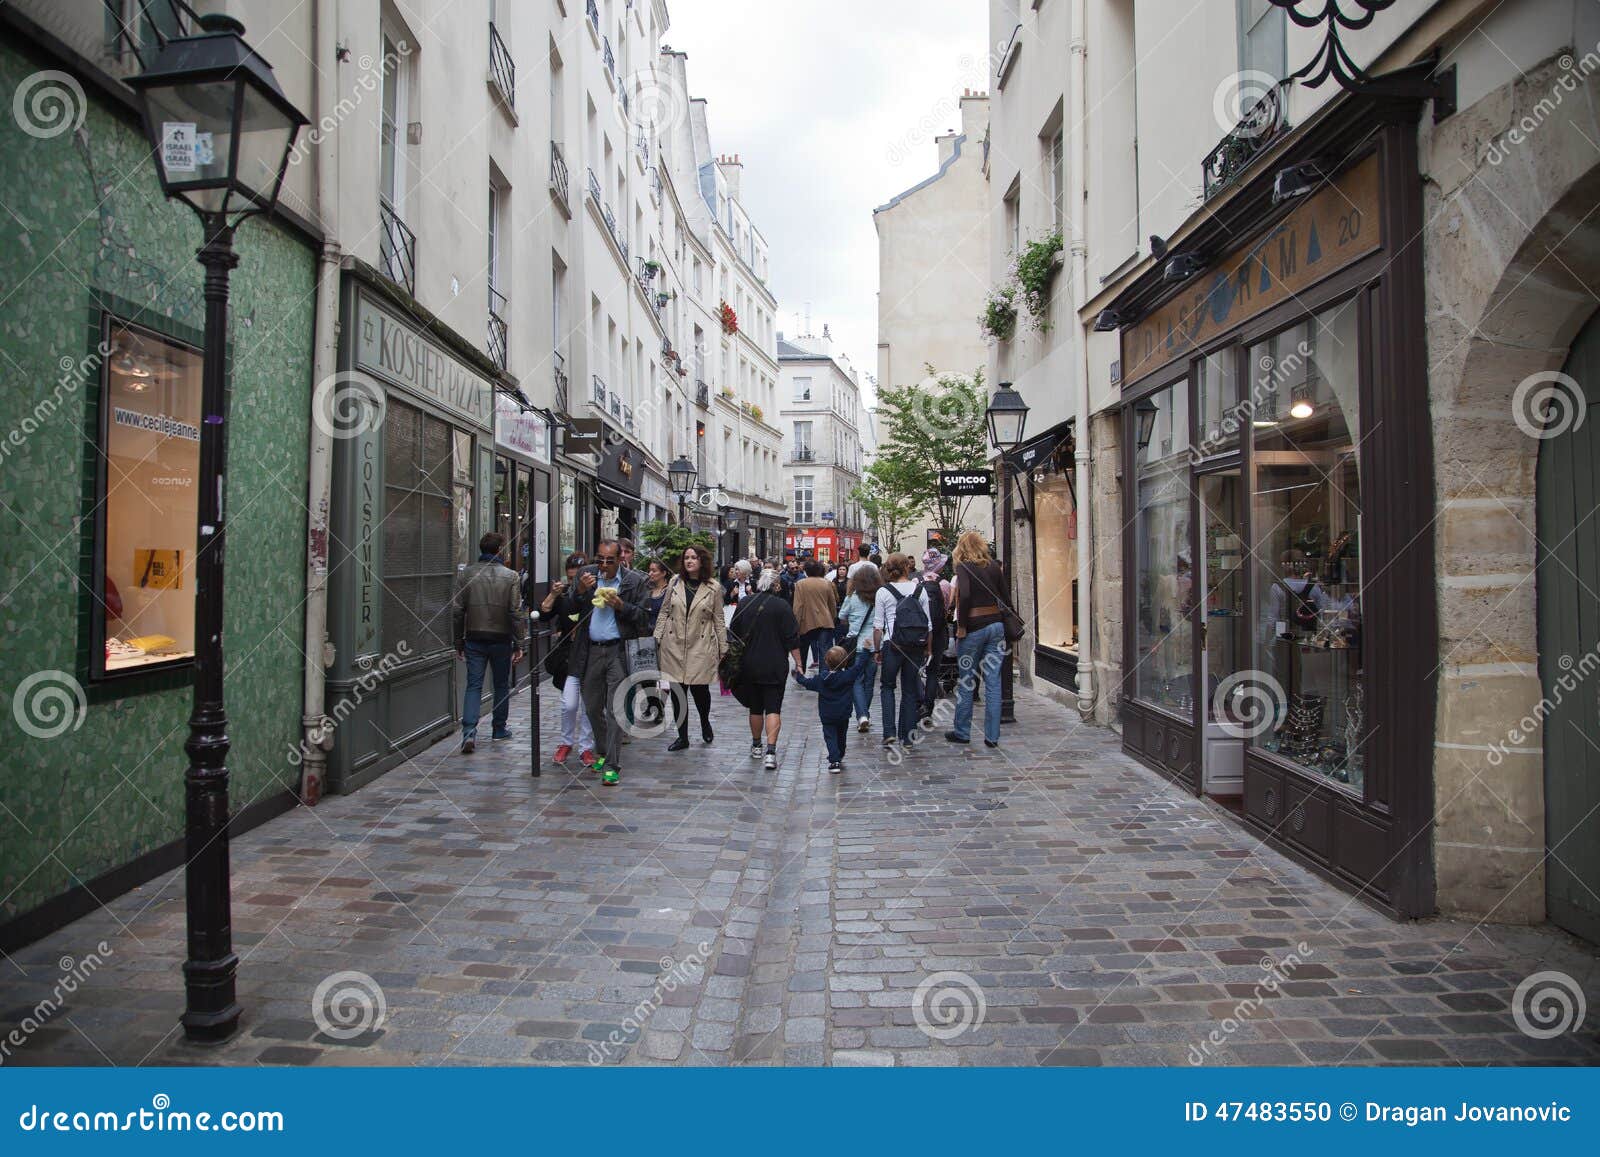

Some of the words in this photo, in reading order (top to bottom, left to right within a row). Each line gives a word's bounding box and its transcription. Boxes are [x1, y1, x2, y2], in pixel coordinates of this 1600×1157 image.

[1337, 207, 1361, 247] 20
[379, 317, 445, 398] KOSHER
[944, 476, 987, 486] suncoo
